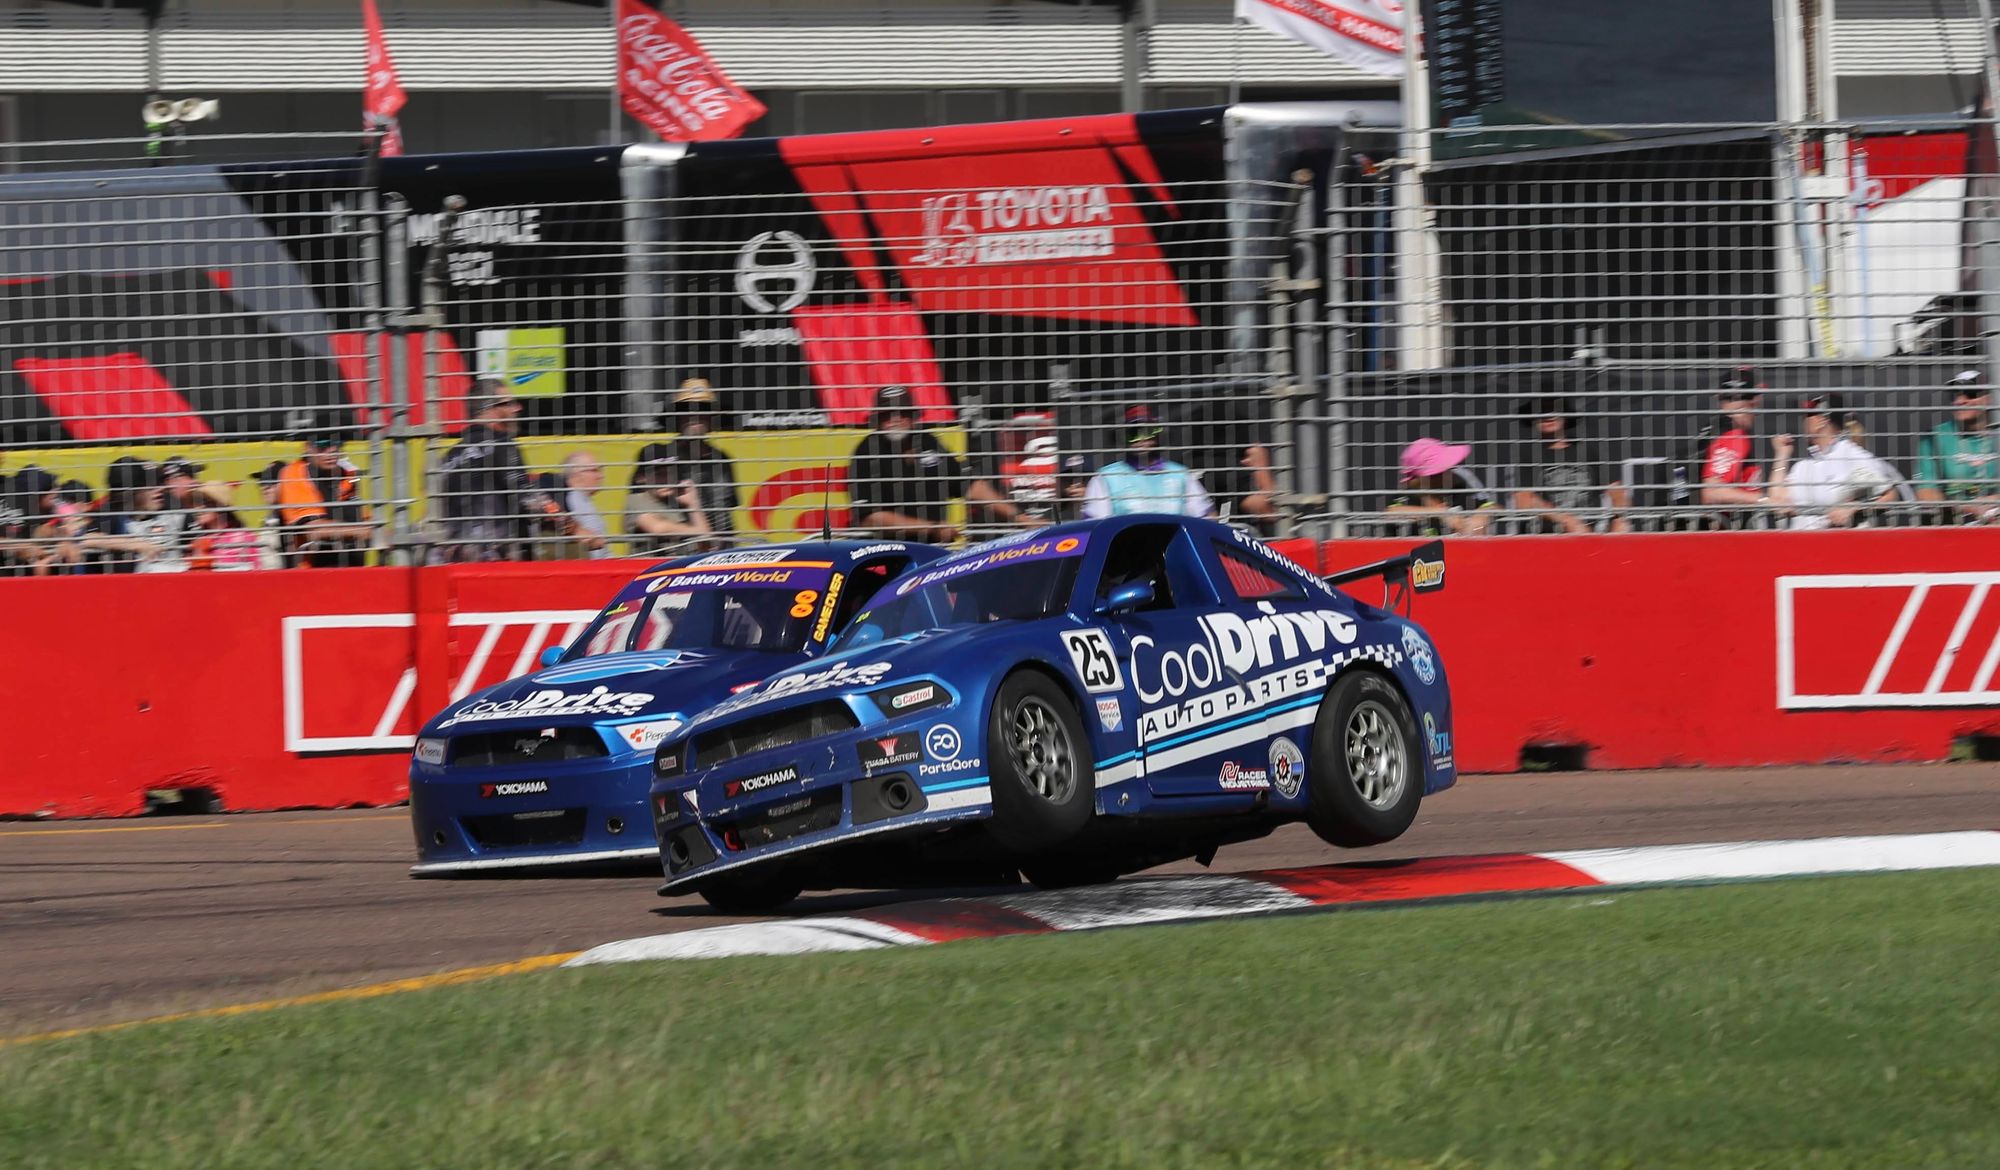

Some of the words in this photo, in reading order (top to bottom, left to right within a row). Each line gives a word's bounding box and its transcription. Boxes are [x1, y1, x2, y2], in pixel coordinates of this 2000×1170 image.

[975, 186, 1114, 230] TOYOTA
[1069, 633, 1116, 687] 25
[902, 688, 932, 706] Castrol
[1144, 698, 1214, 735] AUTO
[1225, 669, 1309, 711] PARTS
[889, 751, 919, 763] BATTERY
[919, 758, 981, 776] PartsQore
[1238, 770, 1267, 780] RACER
[496, 781, 548, 796] YOKOHAMA
[740, 768, 797, 792] YOKOHAMA
